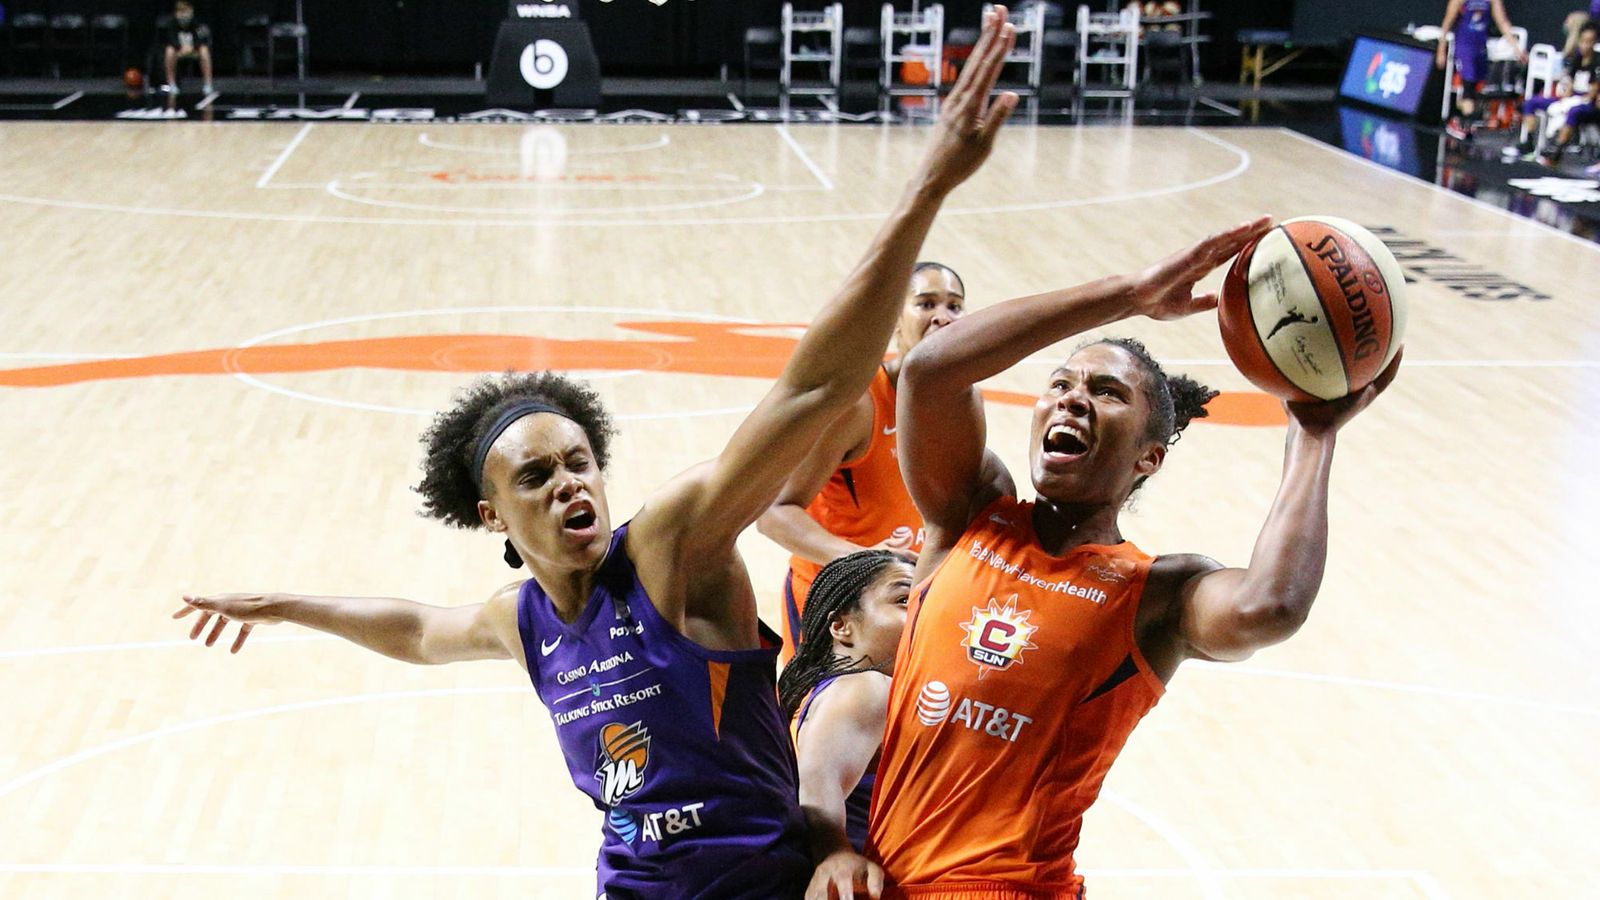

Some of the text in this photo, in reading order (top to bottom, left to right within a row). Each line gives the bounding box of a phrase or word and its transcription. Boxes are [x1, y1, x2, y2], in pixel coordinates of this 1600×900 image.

[515, 4, 571, 19] WNBA
[1306, 234, 1381, 362] SPALDING
[979, 619, 1016, 652] C
[973, 649, 1006, 667] SUN
[950, 697, 1033, 744] AT&T
[641, 801, 705, 842] AT&T
